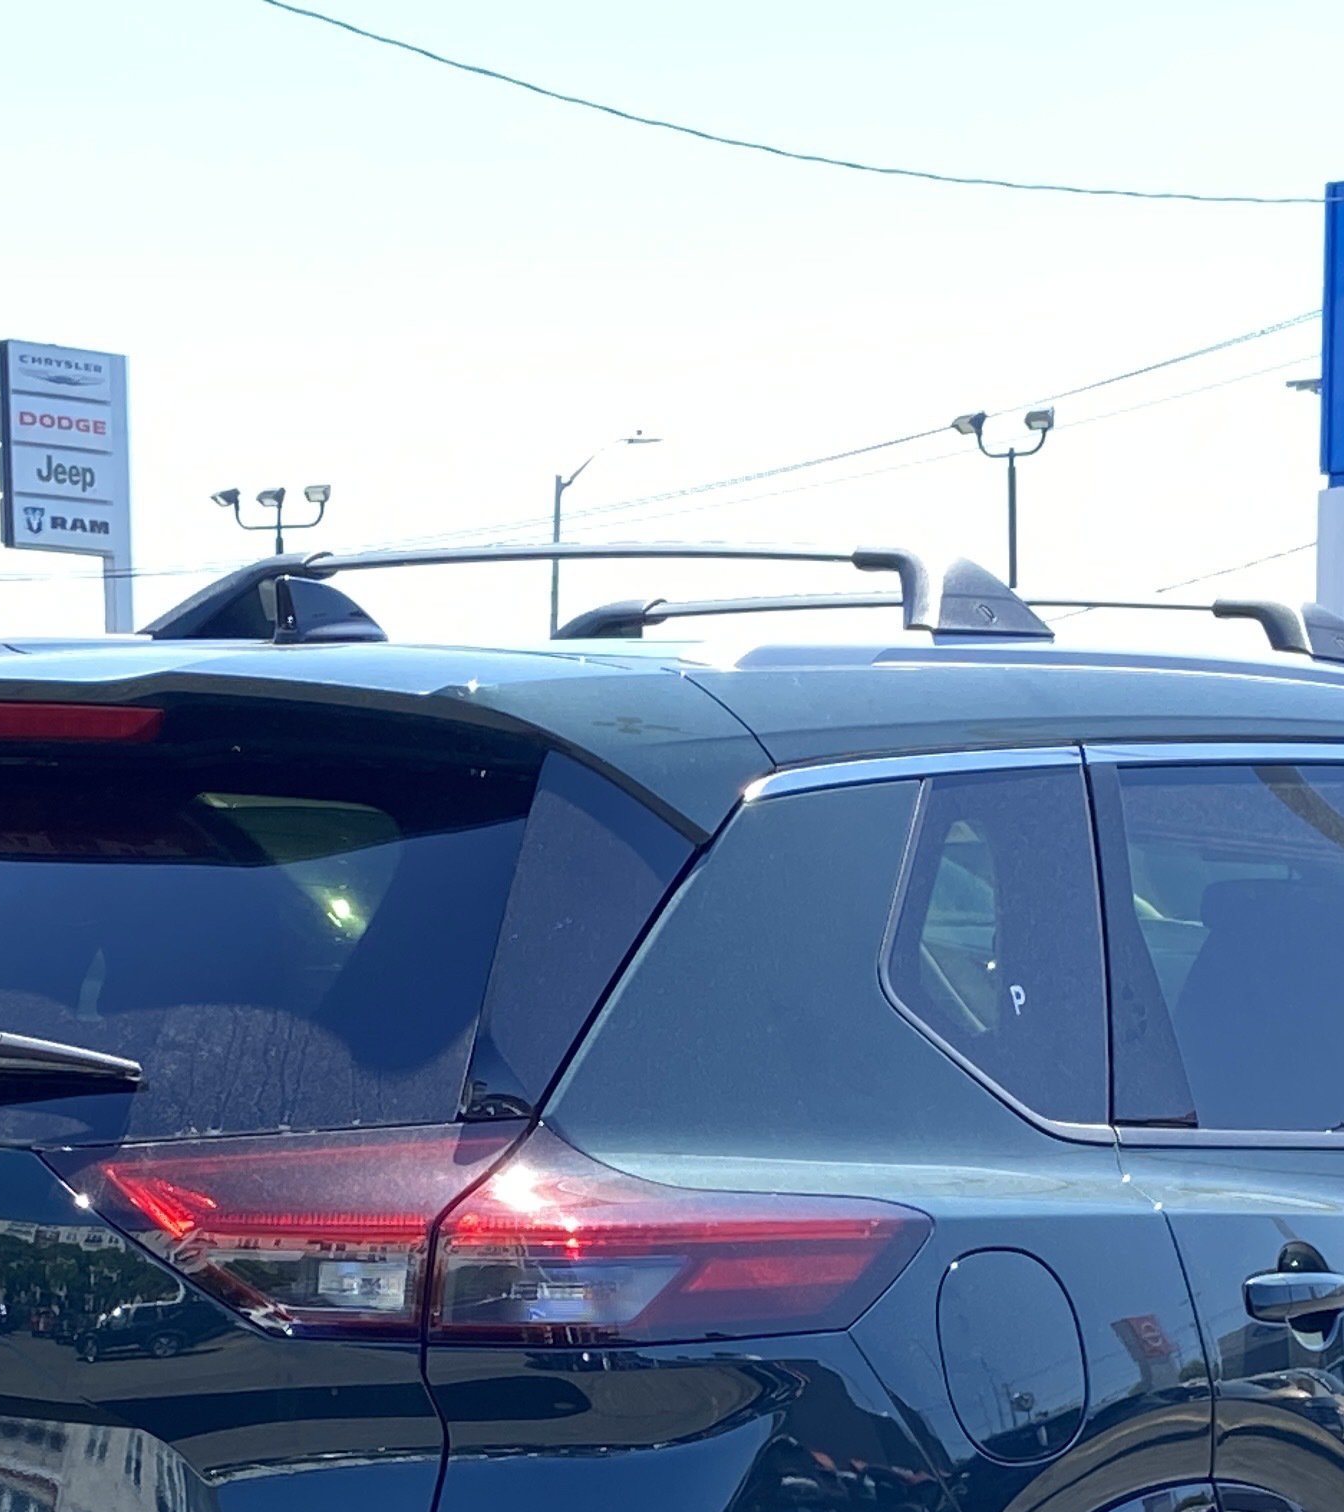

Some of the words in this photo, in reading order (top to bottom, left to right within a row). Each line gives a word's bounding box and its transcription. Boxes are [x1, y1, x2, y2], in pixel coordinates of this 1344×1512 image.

[19, 354, 103, 373] CHRYSLER
[19, 411, 107, 435] DODGE
[36, 454, 96, 493] Jeep
[50, 515, 110, 535] RAM
